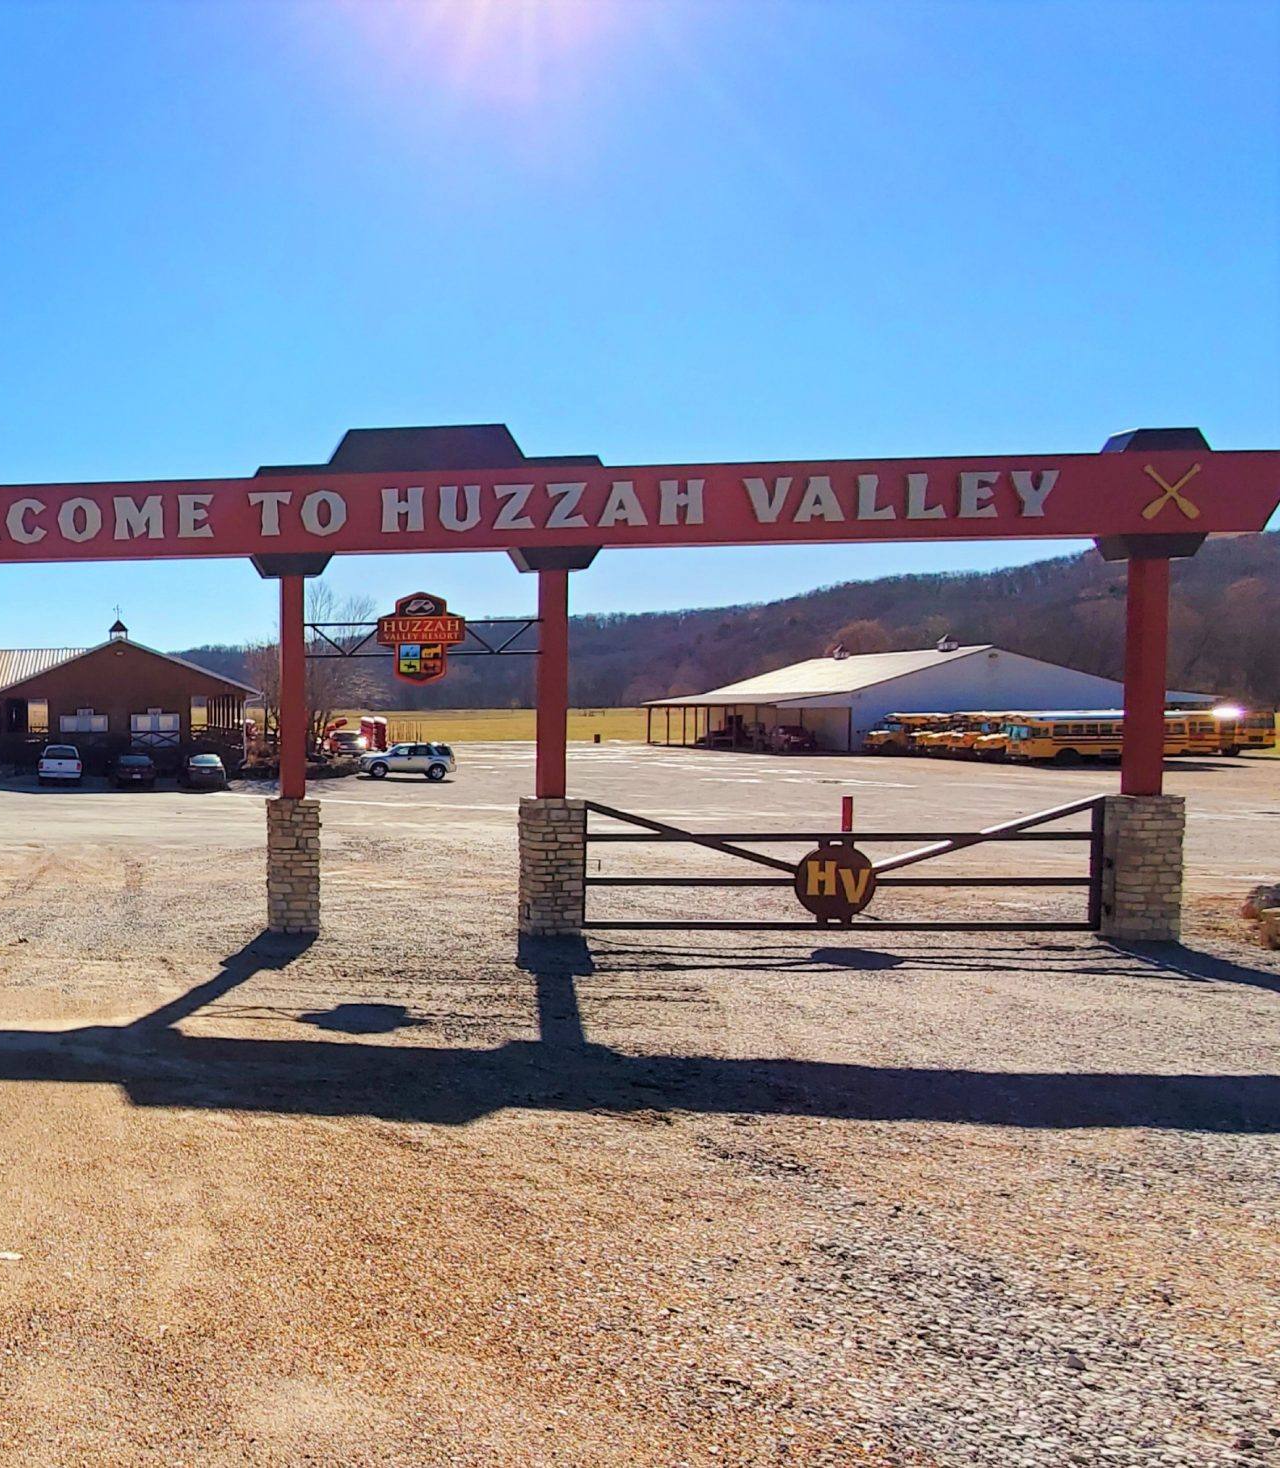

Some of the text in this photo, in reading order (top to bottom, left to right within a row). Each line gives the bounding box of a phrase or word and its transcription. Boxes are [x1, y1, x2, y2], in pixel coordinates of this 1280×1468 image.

[248, 489, 347, 536] TO
[380, 479, 706, 533] HUZZAH
[742, 470, 1060, 523] VALLEY
[383, 620, 459, 632] HUZZAH
[384, 632, 458, 640] VALLEY RESORT
[806, 860, 871, 904] HV
